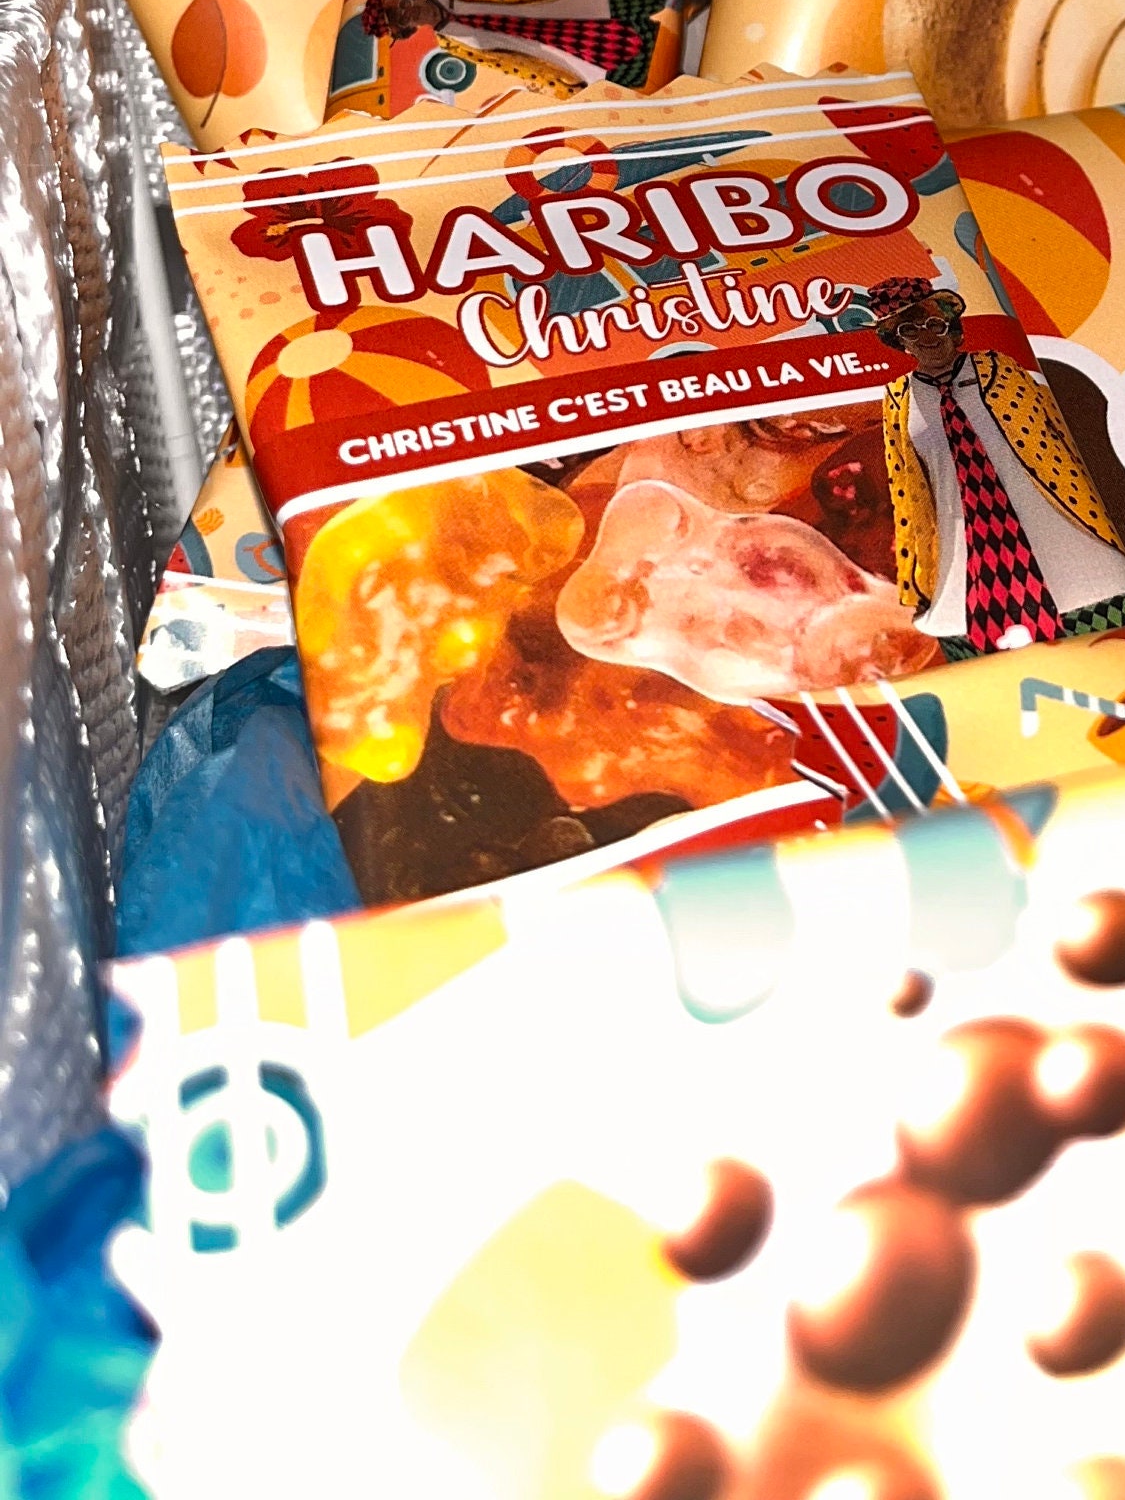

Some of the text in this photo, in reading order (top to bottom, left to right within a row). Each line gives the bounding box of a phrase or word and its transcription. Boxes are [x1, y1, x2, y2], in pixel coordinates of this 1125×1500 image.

[299, 162, 906, 307] HARIBO
[458, 261, 855, 367] Christine
[338, 351, 890, 466] CHRISTINE C'EST BEAU LA VIE...
